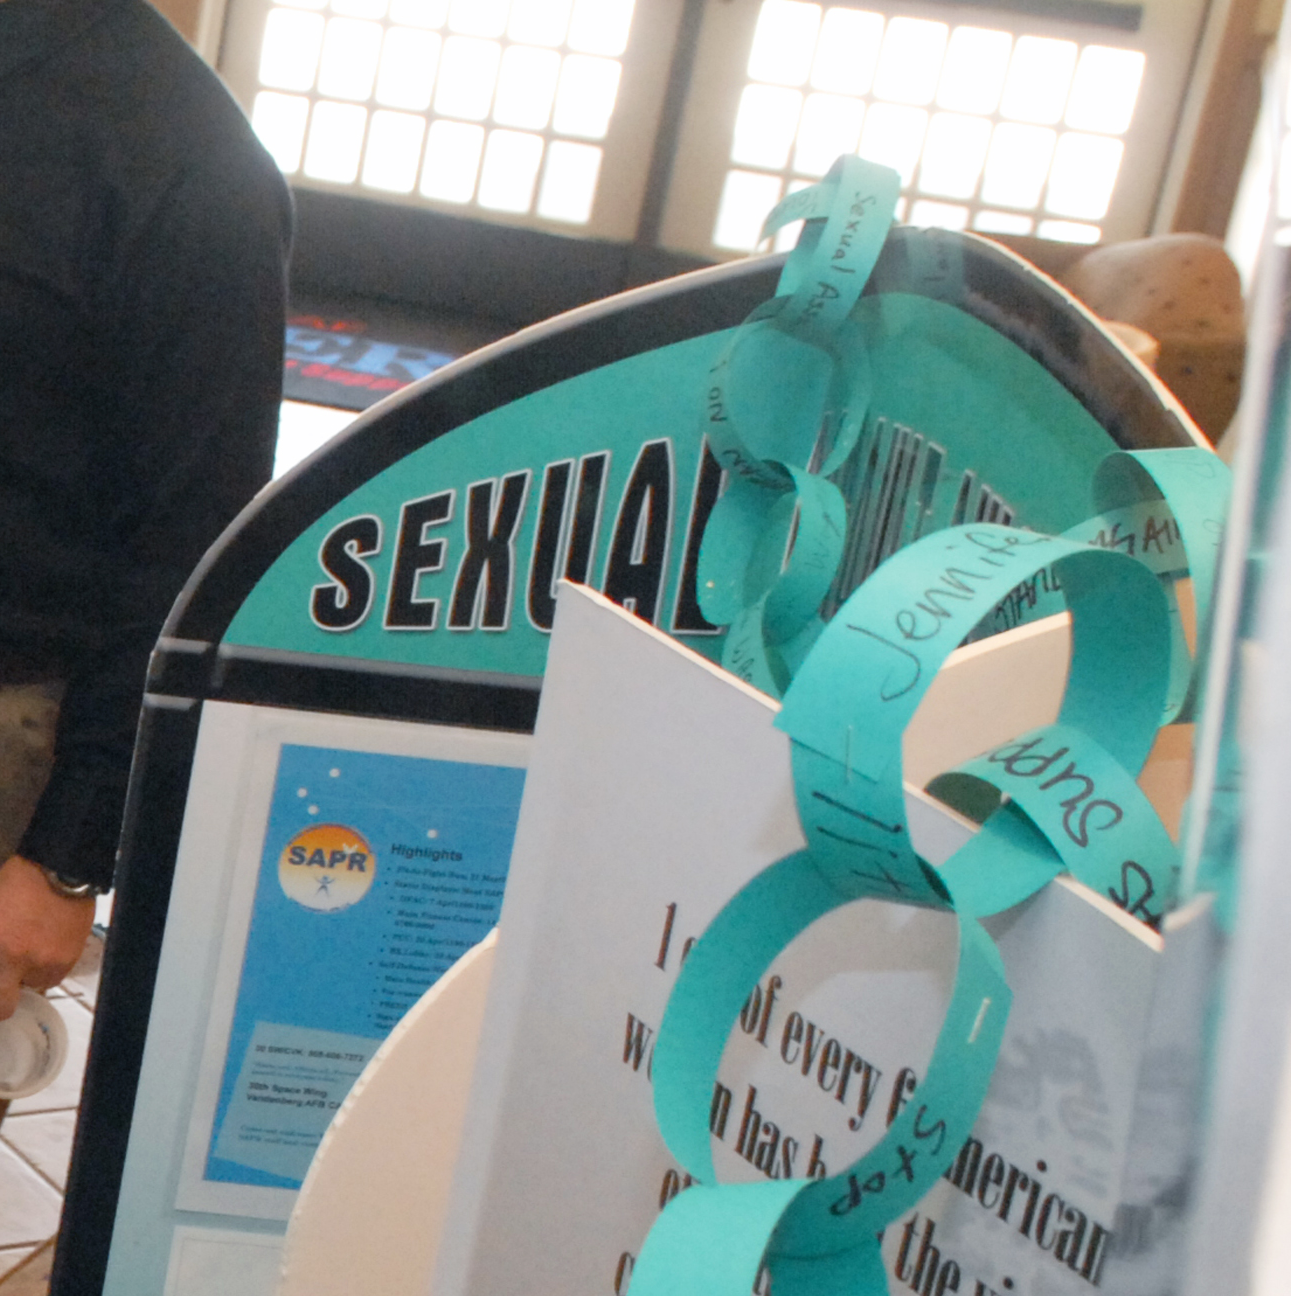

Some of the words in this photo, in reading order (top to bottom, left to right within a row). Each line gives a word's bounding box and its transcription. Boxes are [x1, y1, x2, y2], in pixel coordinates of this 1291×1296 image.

[288, 845, 368, 873] SAPR
[391, 843, 463, 862] Highlights
[779, 1009, 884, 1133] every
[734, 1082, 799, 1181] has
